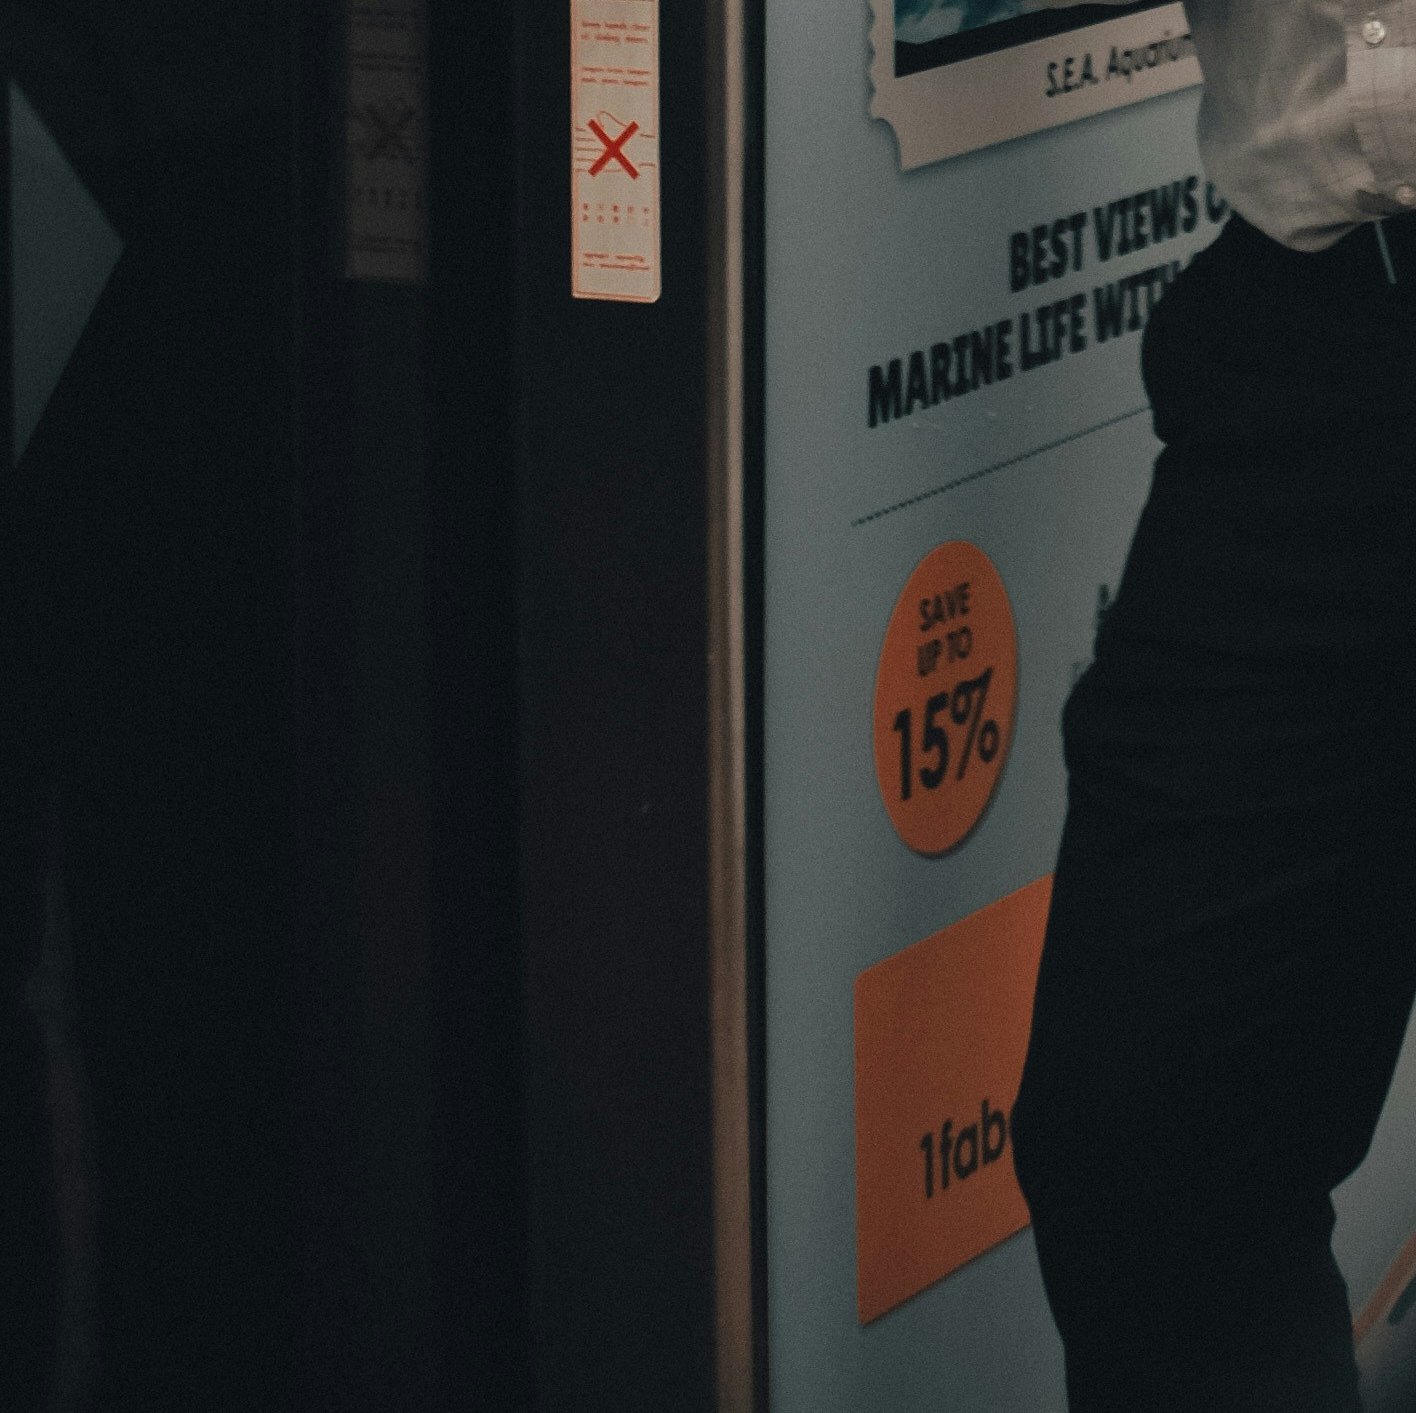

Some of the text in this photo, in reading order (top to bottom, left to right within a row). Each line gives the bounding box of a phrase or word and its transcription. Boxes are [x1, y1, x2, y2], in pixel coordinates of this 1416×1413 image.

[1009, 211, 1088, 294] BEST
[1093, 175, 1199, 263] VIEWS
[868, 259, 1180, 429] MARINE LIFE WIT
[916, 625, 974, 677] UP TO
[919, 582, 971, 632] SAVE
[892, 667, 1001, 801] 15%
